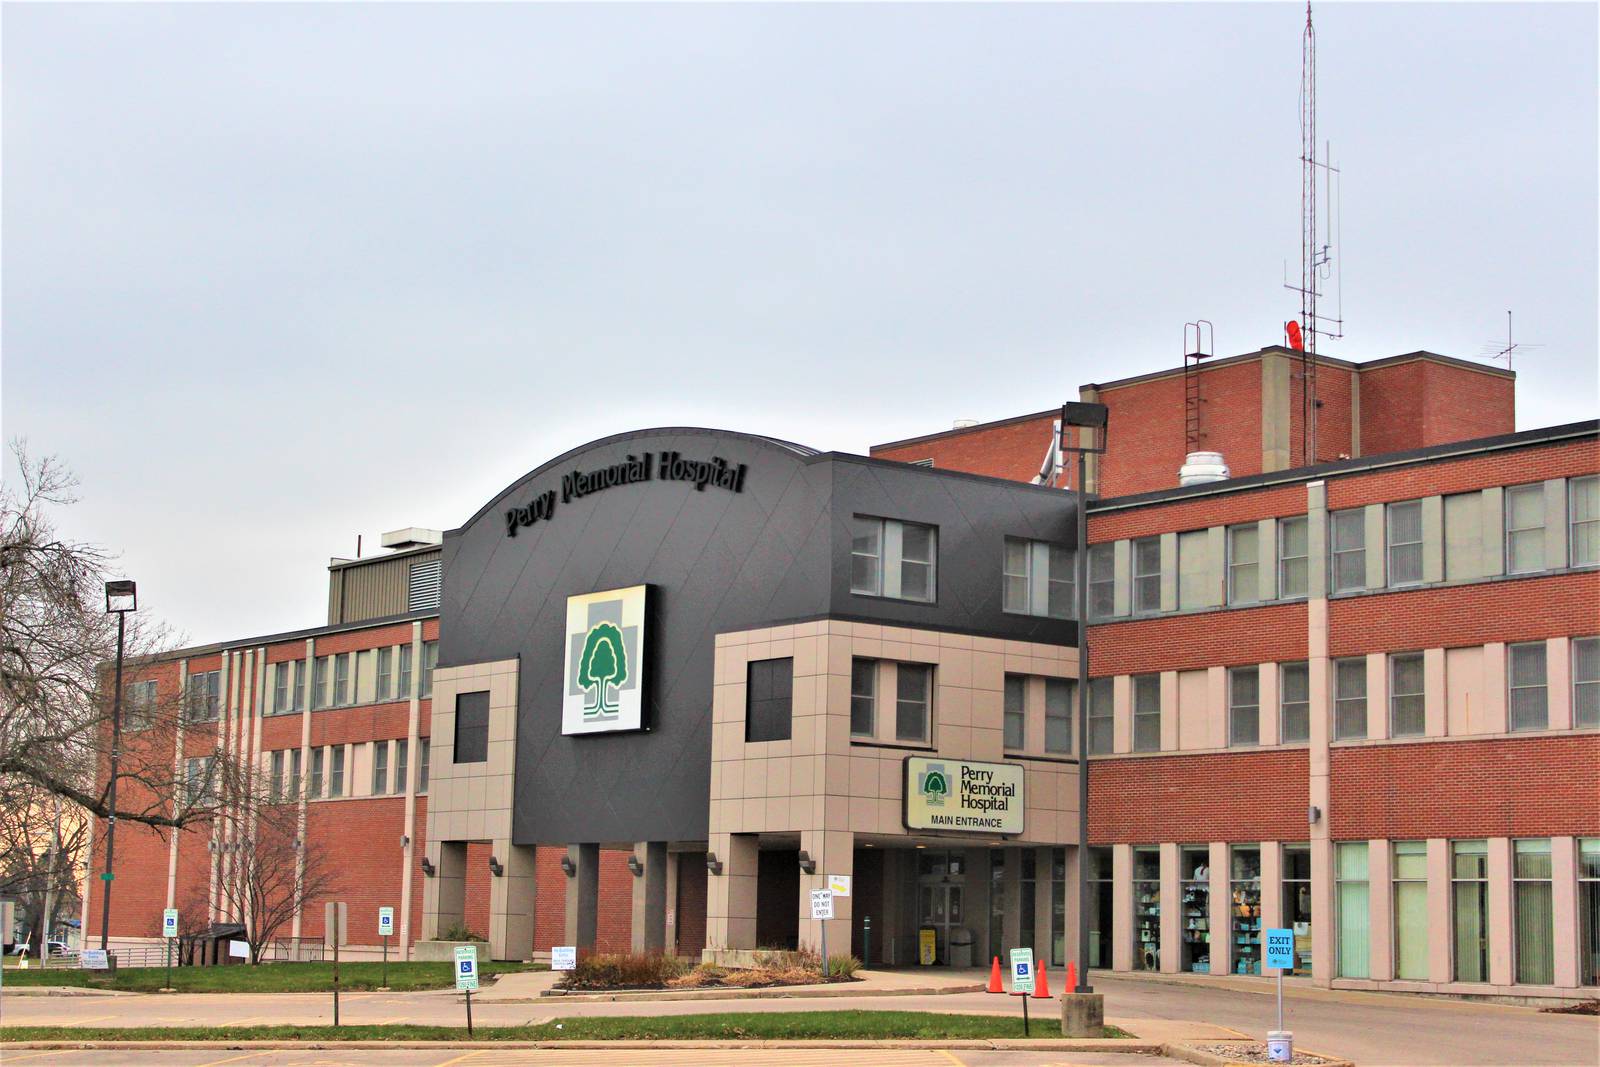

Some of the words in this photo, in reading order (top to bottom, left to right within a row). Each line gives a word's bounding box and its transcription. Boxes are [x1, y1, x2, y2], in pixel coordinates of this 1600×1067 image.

[504, 489, 557, 538] Perry
[561, 451, 654, 504] Memorial
[656, 450, 748, 493] Hospital
[961, 765, 994, 784] Perry
[960, 779, 1015, 797] Memorial
[961, 794, 1008, 813] Hospital
[931, 815, 953, 825] MAIN
[955, 816, 1002, 828] ENTRANCE
[1269, 936, 1290, 945] EXIT
[1268, 946, 1291, 955] ONLY
